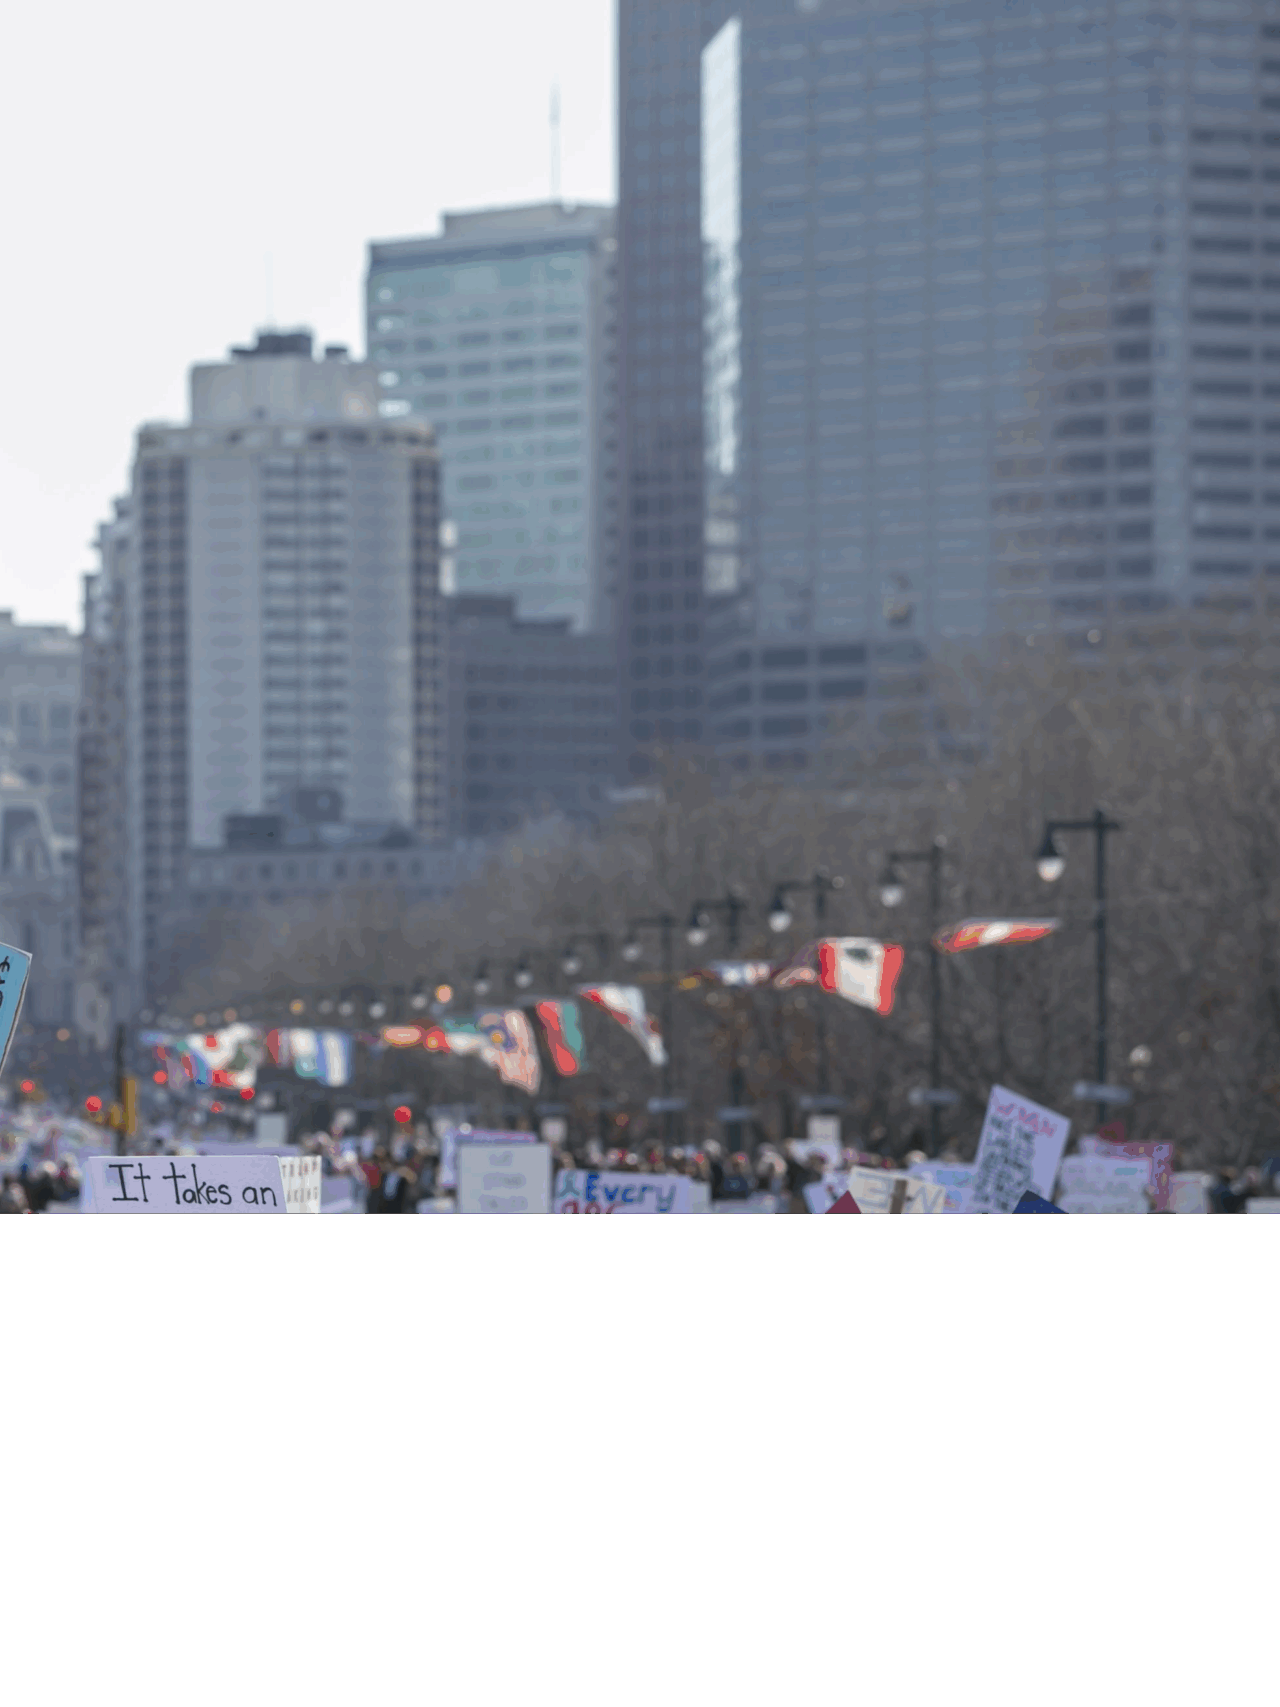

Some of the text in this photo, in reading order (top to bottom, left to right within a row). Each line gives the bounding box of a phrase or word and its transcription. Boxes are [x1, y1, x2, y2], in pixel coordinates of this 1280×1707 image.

[108, 1163, 152, 1202] It
[162, 1162, 232, 1205] takes
[242, 1183, 278, 1206] an
[586, 1171, 677, 1213] Every
